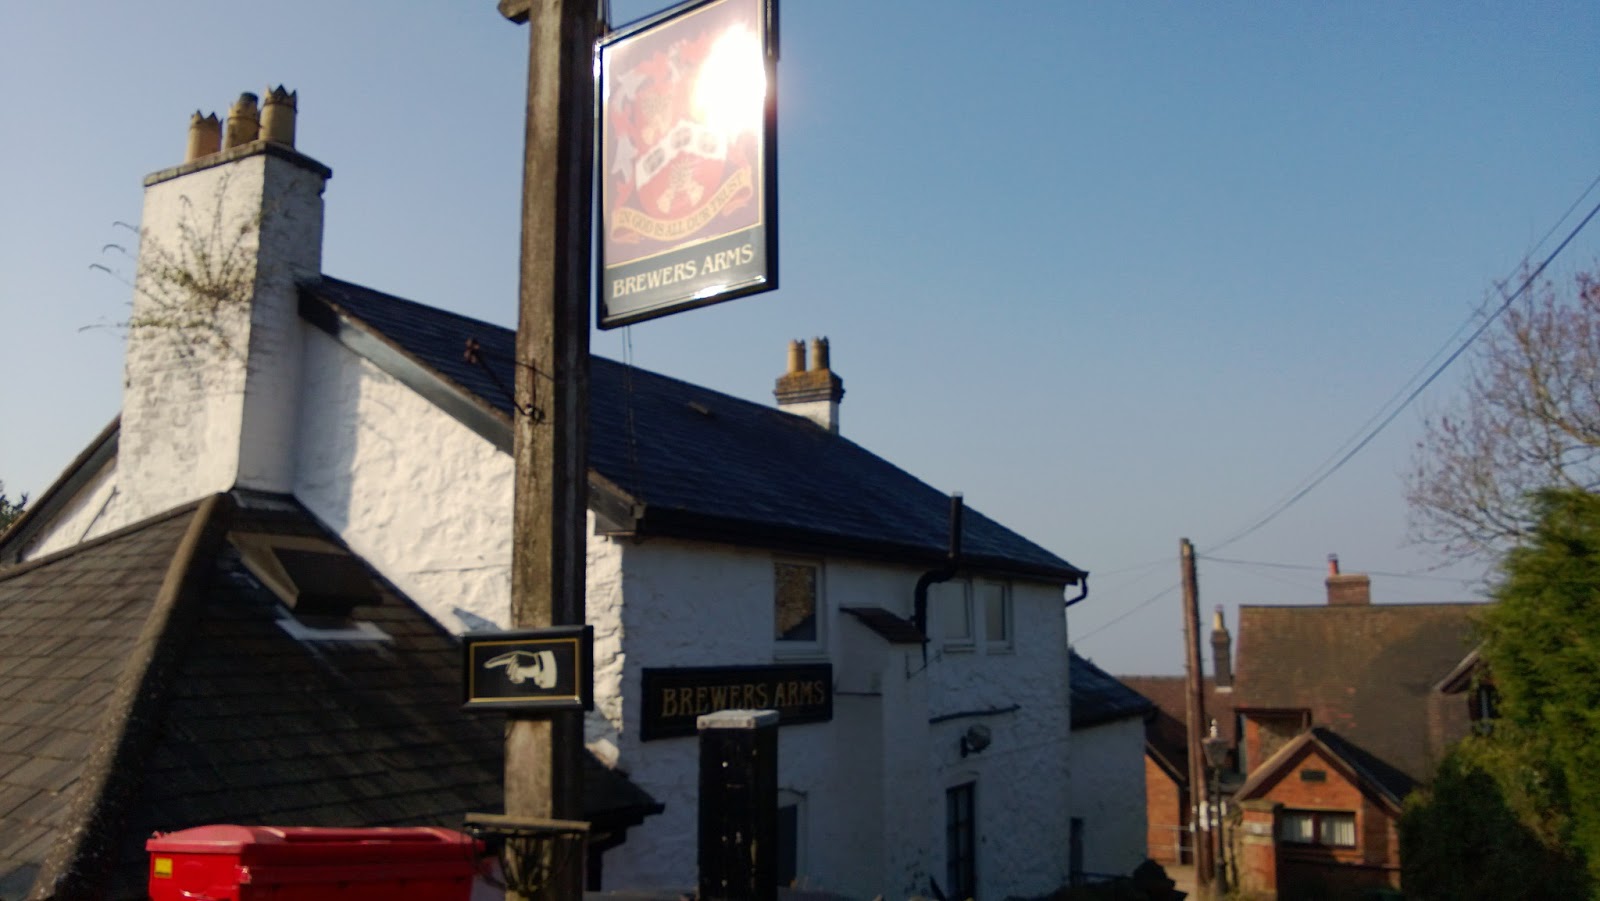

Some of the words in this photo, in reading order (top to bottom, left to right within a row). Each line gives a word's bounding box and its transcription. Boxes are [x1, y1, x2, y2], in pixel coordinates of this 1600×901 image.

[612, 260, 697, 298] BREWERS
[701, 244, 754, 275] ARMS
[661, 682, 769, 717] BREWERS
[774, 680, 825, 707] ARMS
